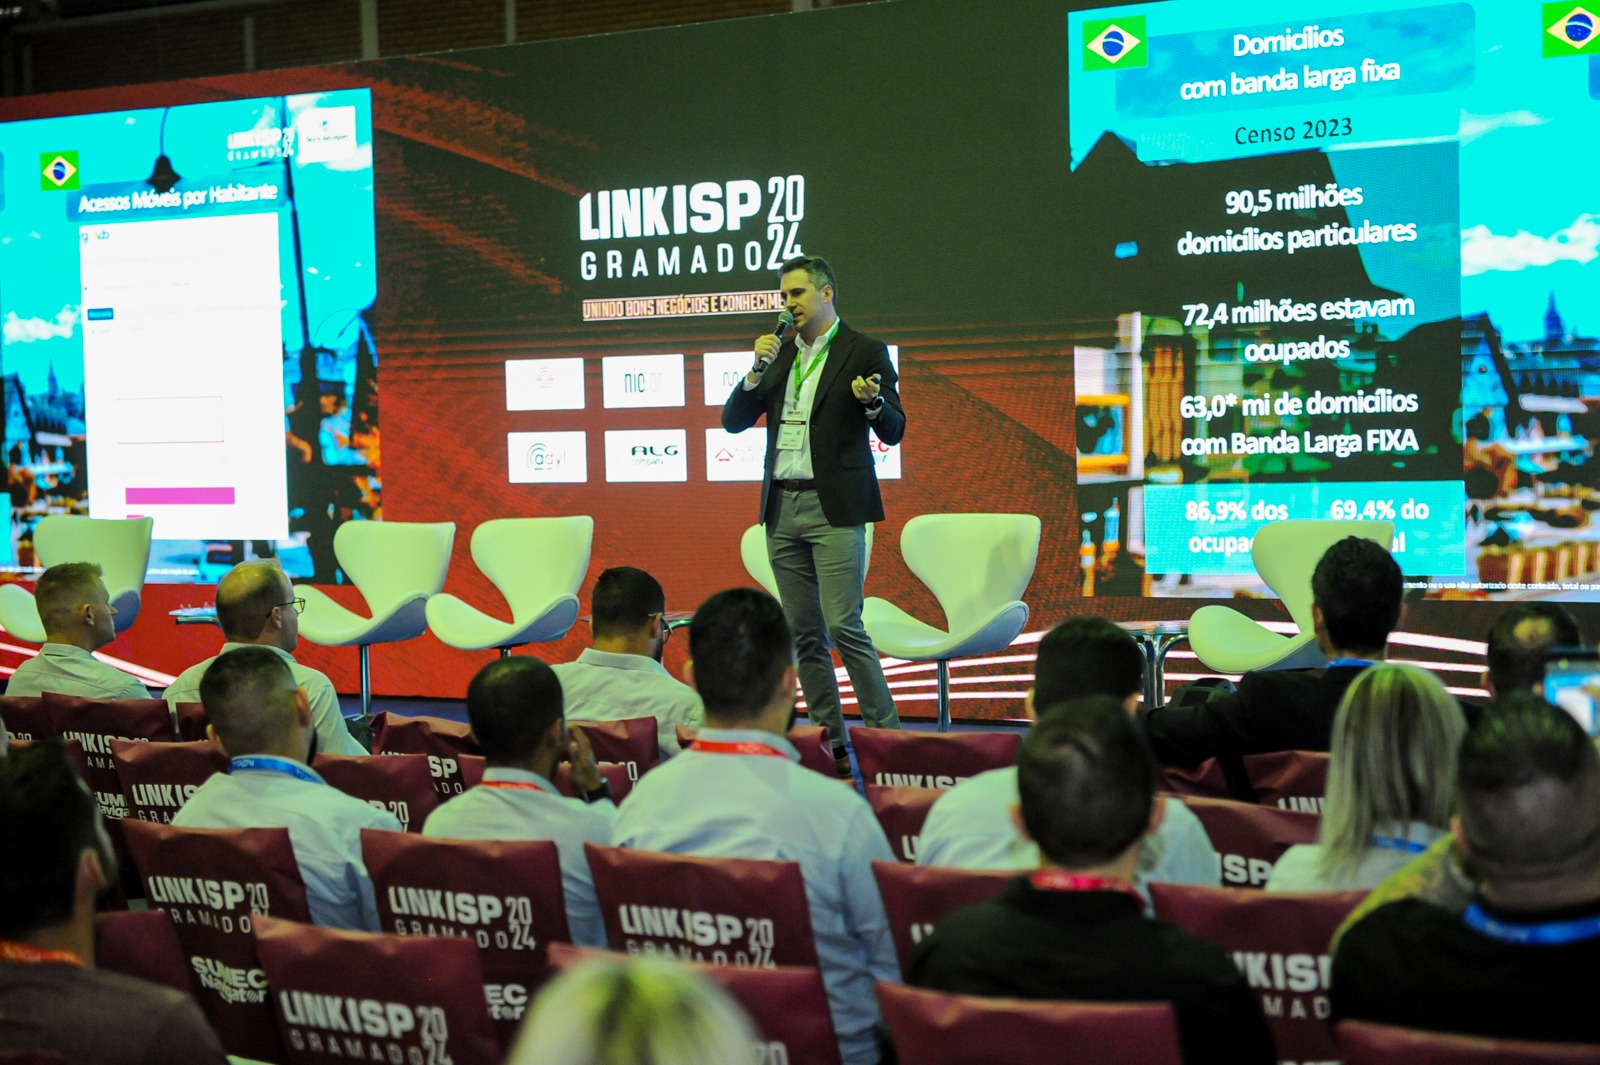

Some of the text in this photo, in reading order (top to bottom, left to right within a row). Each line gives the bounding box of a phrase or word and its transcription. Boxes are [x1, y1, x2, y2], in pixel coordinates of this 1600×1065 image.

[1233, 26, 1345, 58] Domicílios
[1180, 58, 1401, 101] com banda larga fixa
[1235, 117, 1353, 146] Censo 2023
[78, 183, 279, 213] Acessos Móveis por Habitante
[579, 174, 805, 241] LINKISP 20
[1225, 184, 1364, 217] 90,5 milhões
[580, 221, 806, 281] GRAMADO 24
[1177, 220, 1418, 256] domicílios particulares
[583, 292, 785, 319] UNINDO BONS NEGÓCIOS E CONHECIME
[1182, 296, 1415, 329] 72,4 milhões estavam
[1244, 335, 1351, 365] ocupados
[1242, 393, 1271, 416] mi
[1274, 391, 1303, 416] de
[1306, 387, 1418, 415] domicílios
[1181, 428, 1420, 458] com Banda Larga FIXA
[1185, 499, 1289, 525] 86,9% dos
[1400, 498, 1430, 521] do
[1188, 535, 1253, 557] ocupa
[148, 876, 269, 910] LINKISP 20
[388, 886, 533, 925] LINKISP 20
[509, 924, 536, 950] 24
[619, 904, 774, 949] LINKISP 20
[279, 990, 415, 1039] LINKISP
